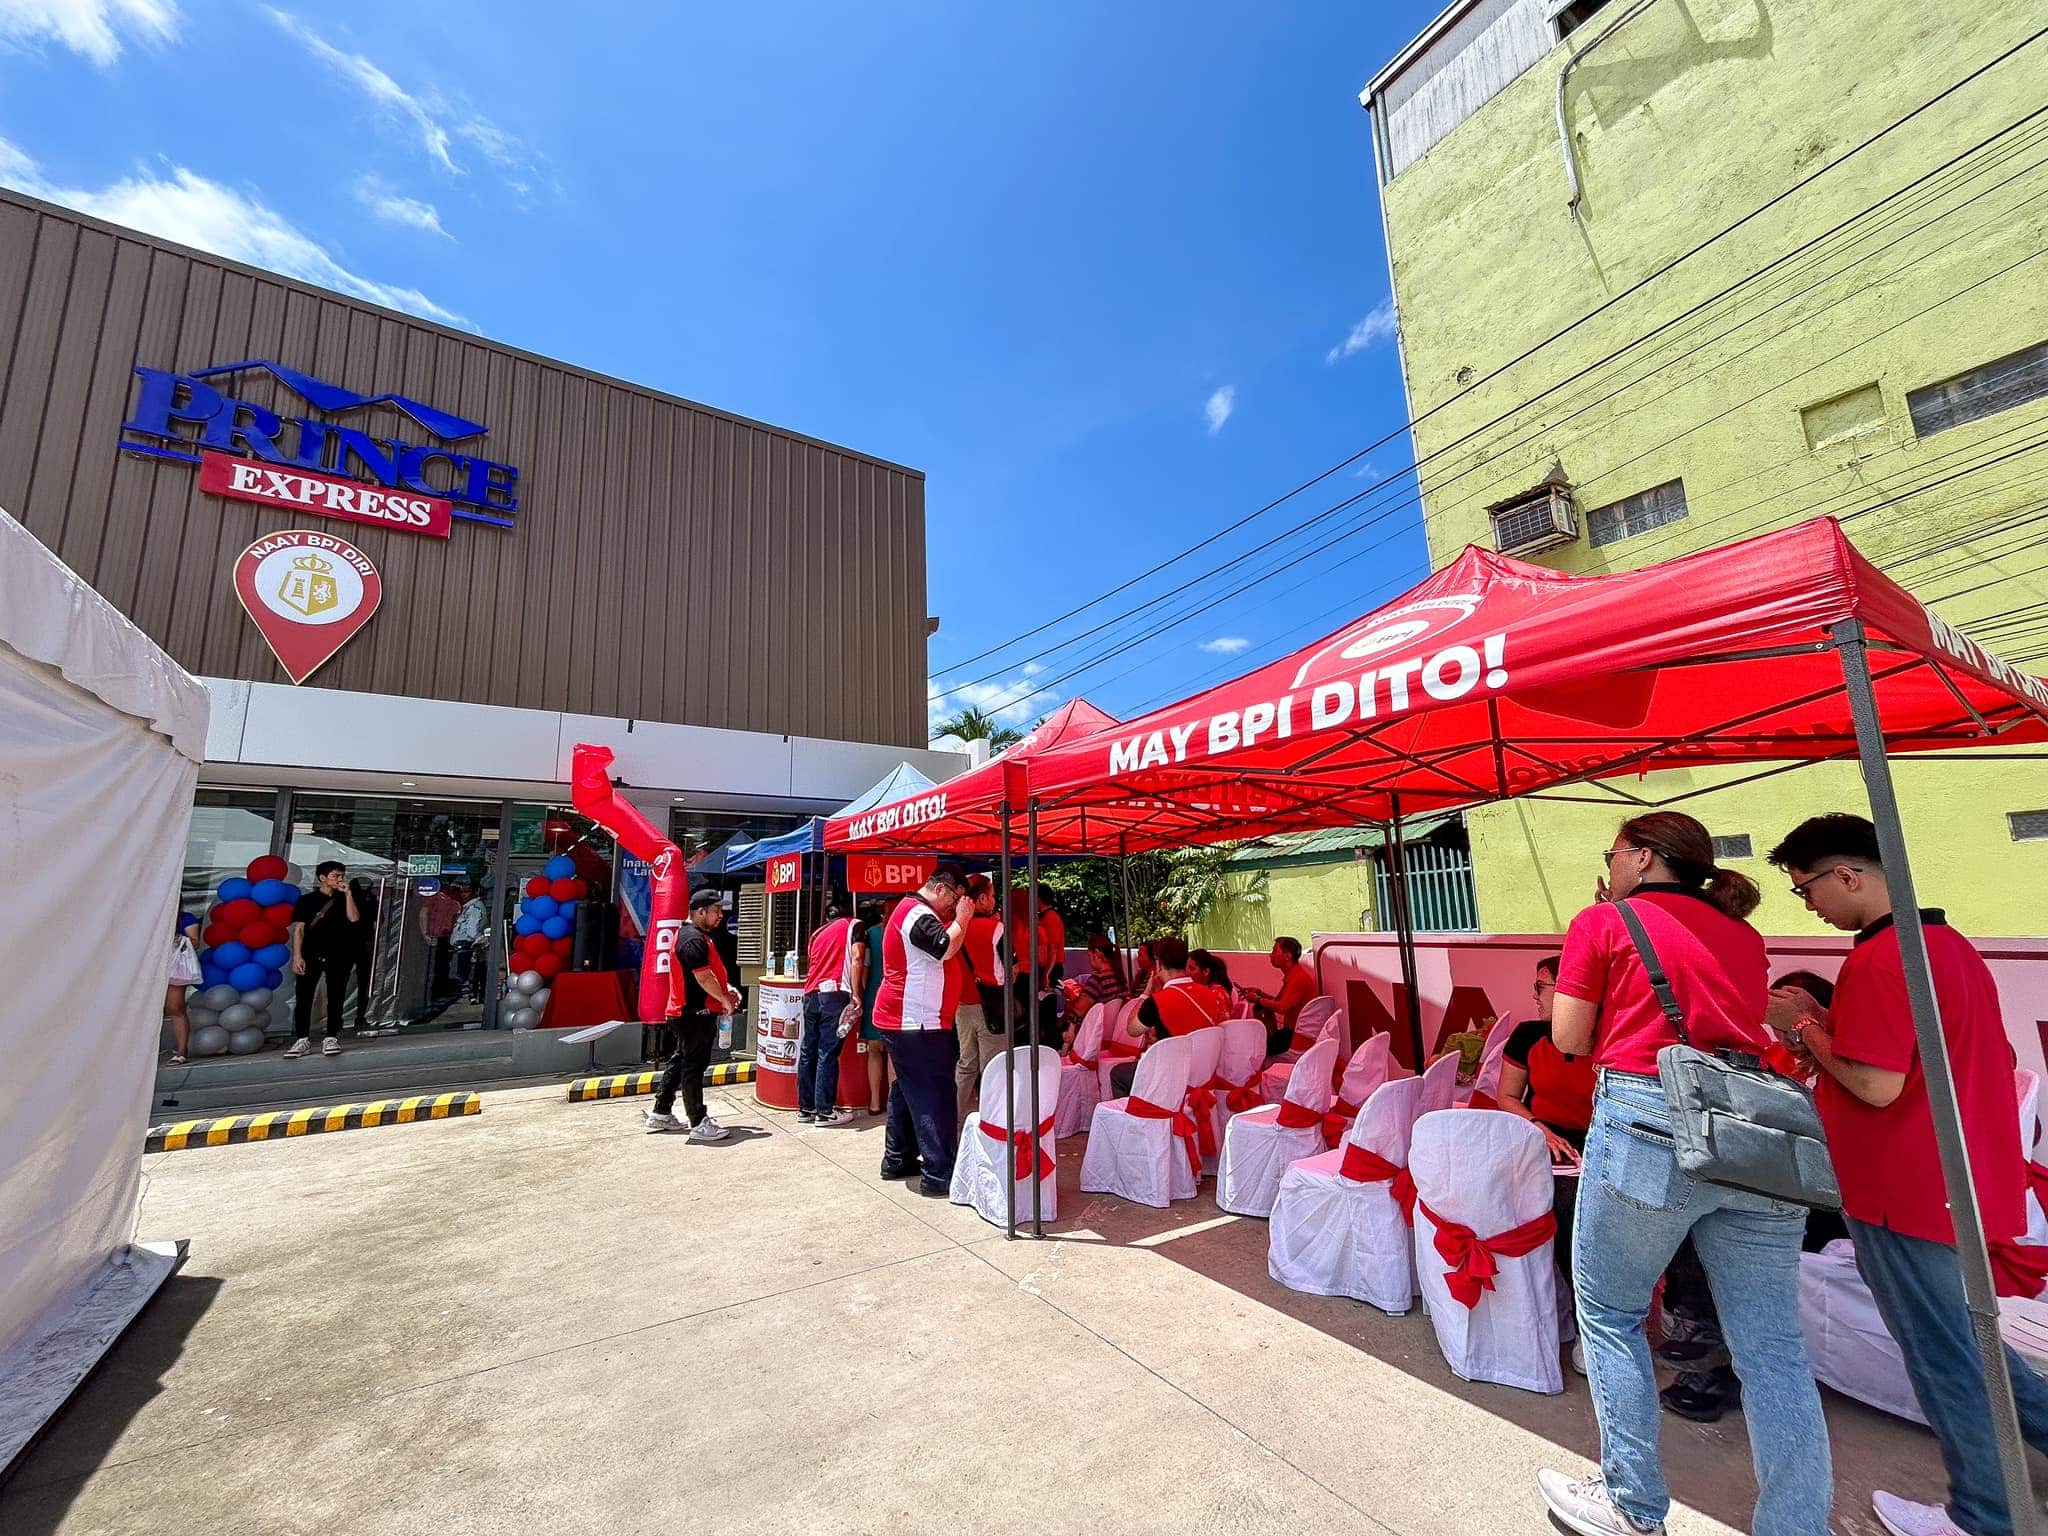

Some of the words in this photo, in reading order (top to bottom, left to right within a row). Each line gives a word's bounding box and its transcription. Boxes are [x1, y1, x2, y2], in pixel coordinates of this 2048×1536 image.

[121, 365, 520, 513] PRINCE
[228, 463, 432, 527] EXPRESS
[249, 534, 300, 559] NAAY
[307, 534, 341, 552] BPI
[341, 548, 374, 576] DIRI
[1108, 720, 1200, 777] MAY
[1207, 694, 1294, 755] BPI
[1311, 633, 1510, 732] DITO!
[848, 816, 874, 842] MAY
[876, 808, 901, 835] BPI
[903, 792, 948, 828] DITO!
[411, 863, 438, 873] OPEN
[779, 861, 796, 884] BPI
[885, 864, 923, 884] BPI
